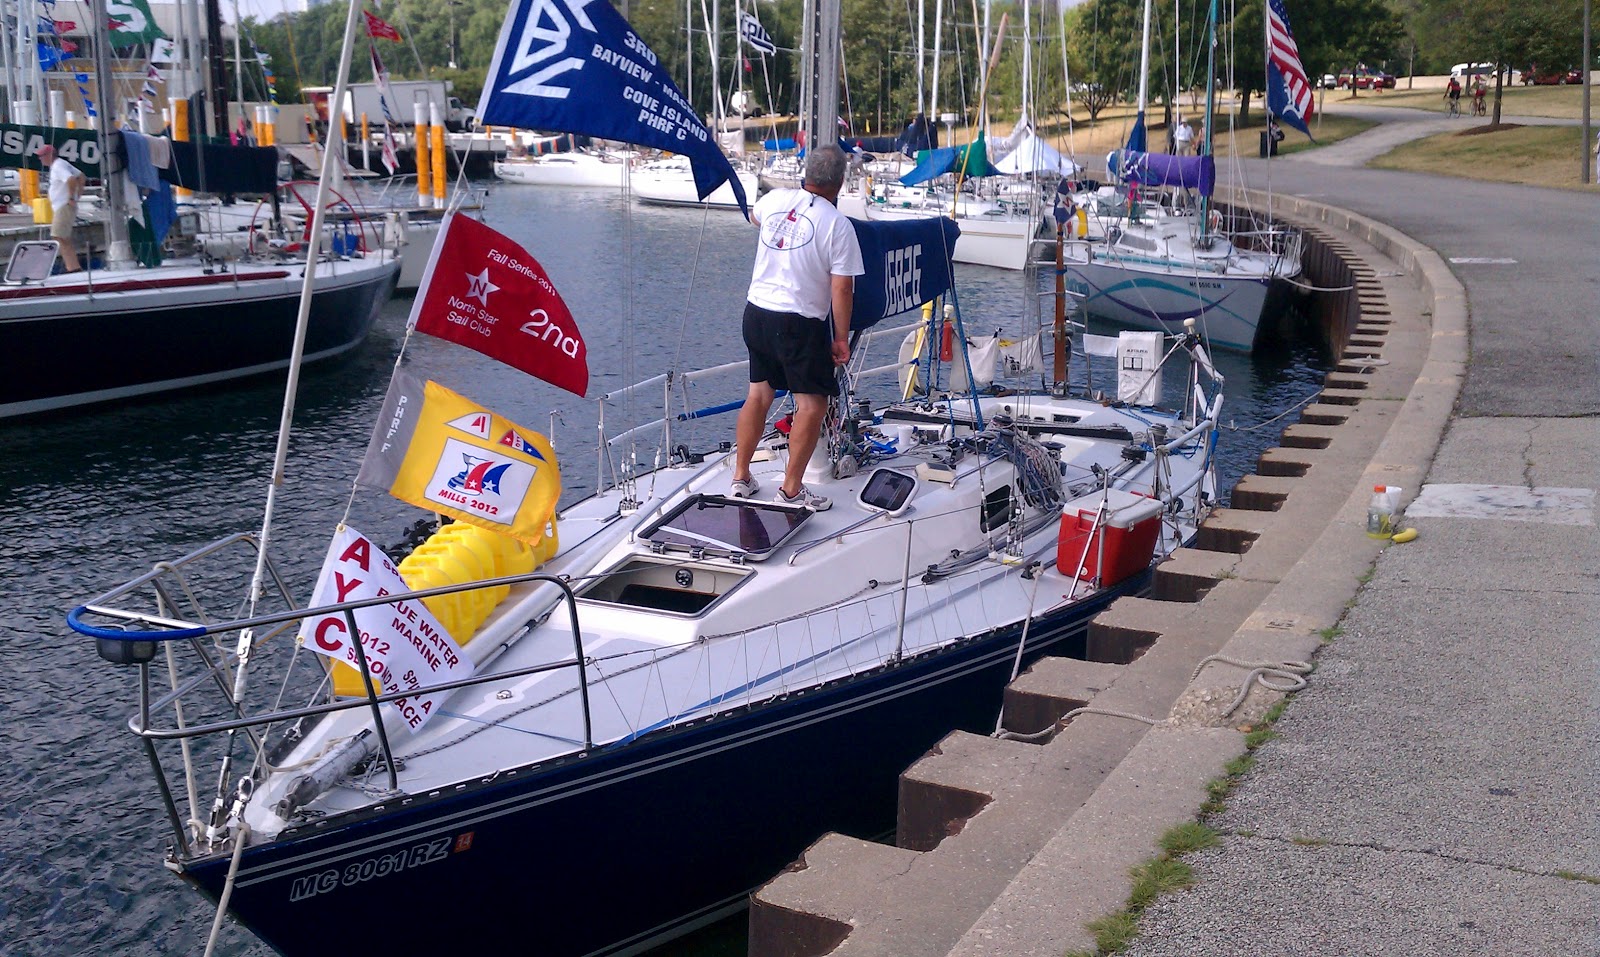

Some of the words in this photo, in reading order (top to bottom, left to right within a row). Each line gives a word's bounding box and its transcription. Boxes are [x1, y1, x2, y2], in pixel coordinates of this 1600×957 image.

[591, 43, 653, 83] BAYVIEW
[624, 30, 658, 66] 3RD
[622, 85, 660, 112] COVE
[661, 104, 708, 142] ISLAND
[637, 108, 676, 134] PHRF
[676, 127, 687, 141] C
[0, 129, 47, 157] SA
[472, 278, 489, 297] N
[487, 248, 509, 265] Fall
[507, 258, 538, 281] Series
[538, 277, 556, 297] 2011
[446, 310, 470, 326] Sail
[469, 319, 492, 338] Club
[447, 295, 477, 315] North
[477, 309, 500, 325] Star
[519, 308, 580, 359] 2nd
[437, 489, 467, 504] MILLS
[470, 499, 499, 516] 2012
[391, 617, 442, 673] MARINE
[418, 619, 460, 670] WATER
[420, 700, 433, 715] A
[289, 869, 341, 902] MC
